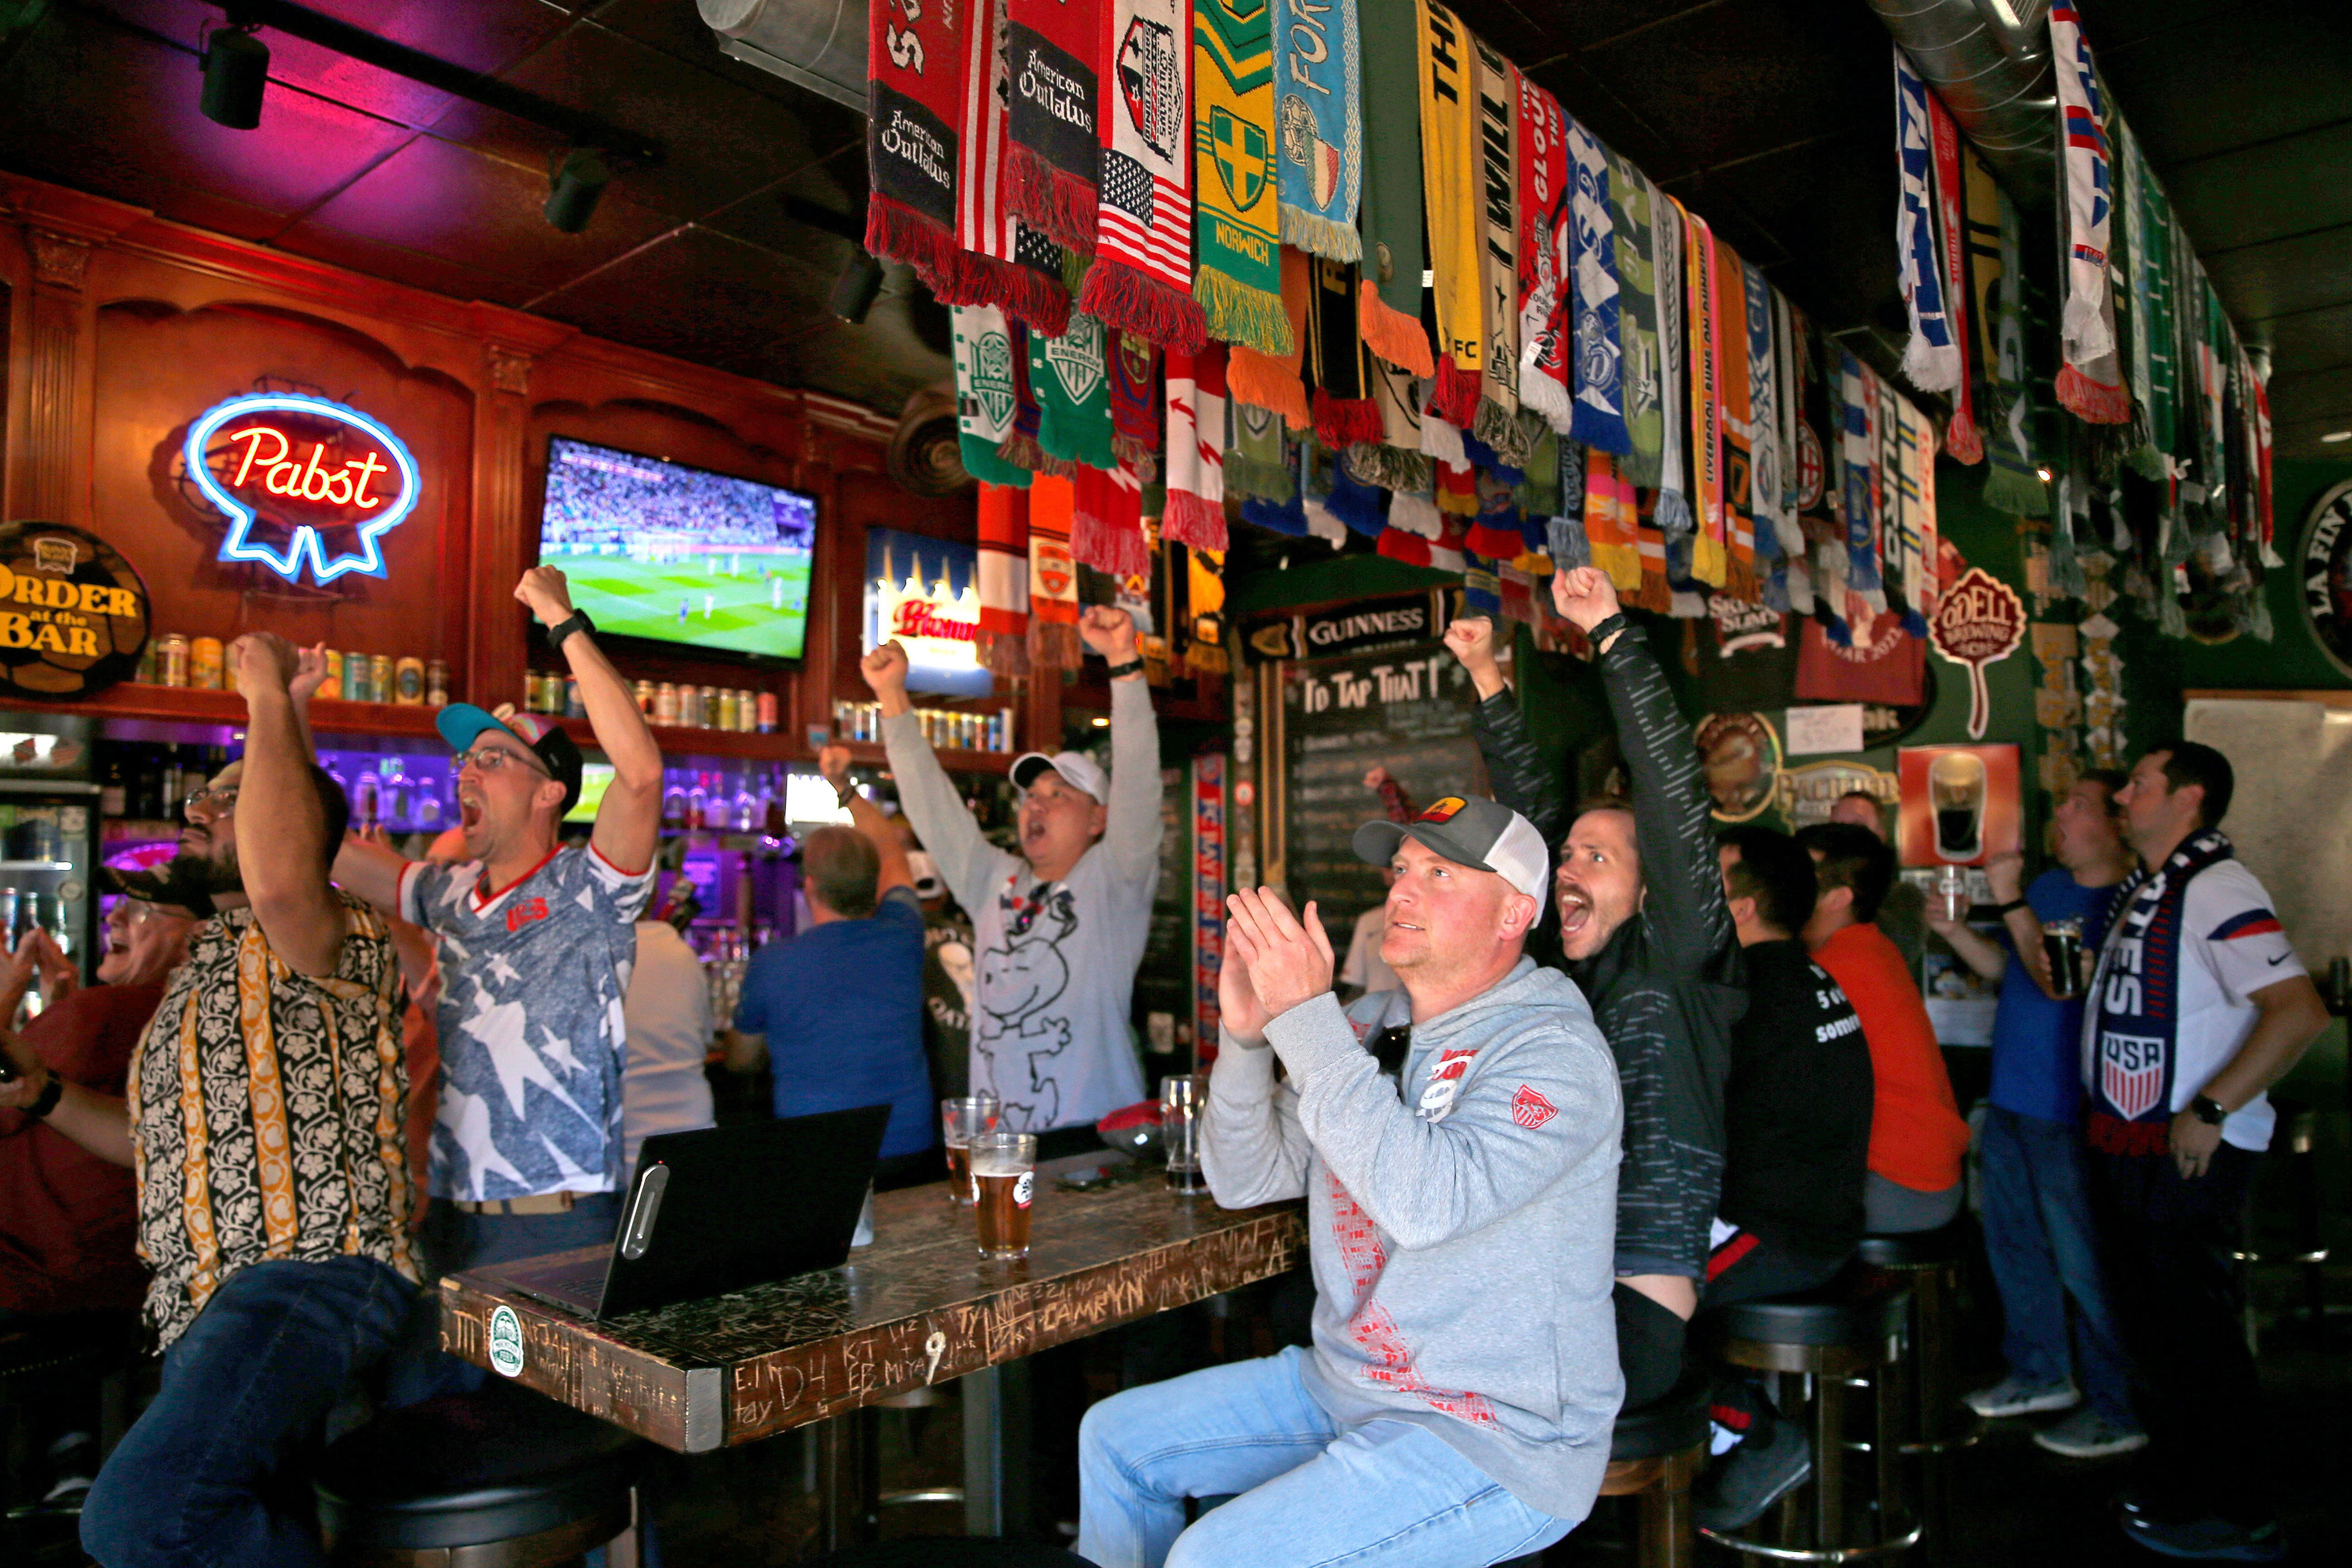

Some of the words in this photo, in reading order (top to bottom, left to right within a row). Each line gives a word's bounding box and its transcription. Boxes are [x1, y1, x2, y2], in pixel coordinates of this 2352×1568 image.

[1028, 48, 1085, 101] American
[891, 110, 944, 159] American
[1216, 220, 1269, 266] NORWICH
[1454, 339, 1477, 358] FC
[1703, 317, 1712, 343] ON
[1051, 347, 1101, 368] ENERGY
[1704, 348, 1712, 391] RUNS
[1705, 399, 1715, 484] LIVERPOOL
[229, 427, 388, 509] Pabst
[0, 611, 99, 657] BAR
[30, 610, 51, 622] at
[55, 611, 87, 627] the
[1309, 607, 1424, 645] GUINNESS
[1330, 670, 1372, 709] TAP
[2106, 1041, 2161, 1071] USA
